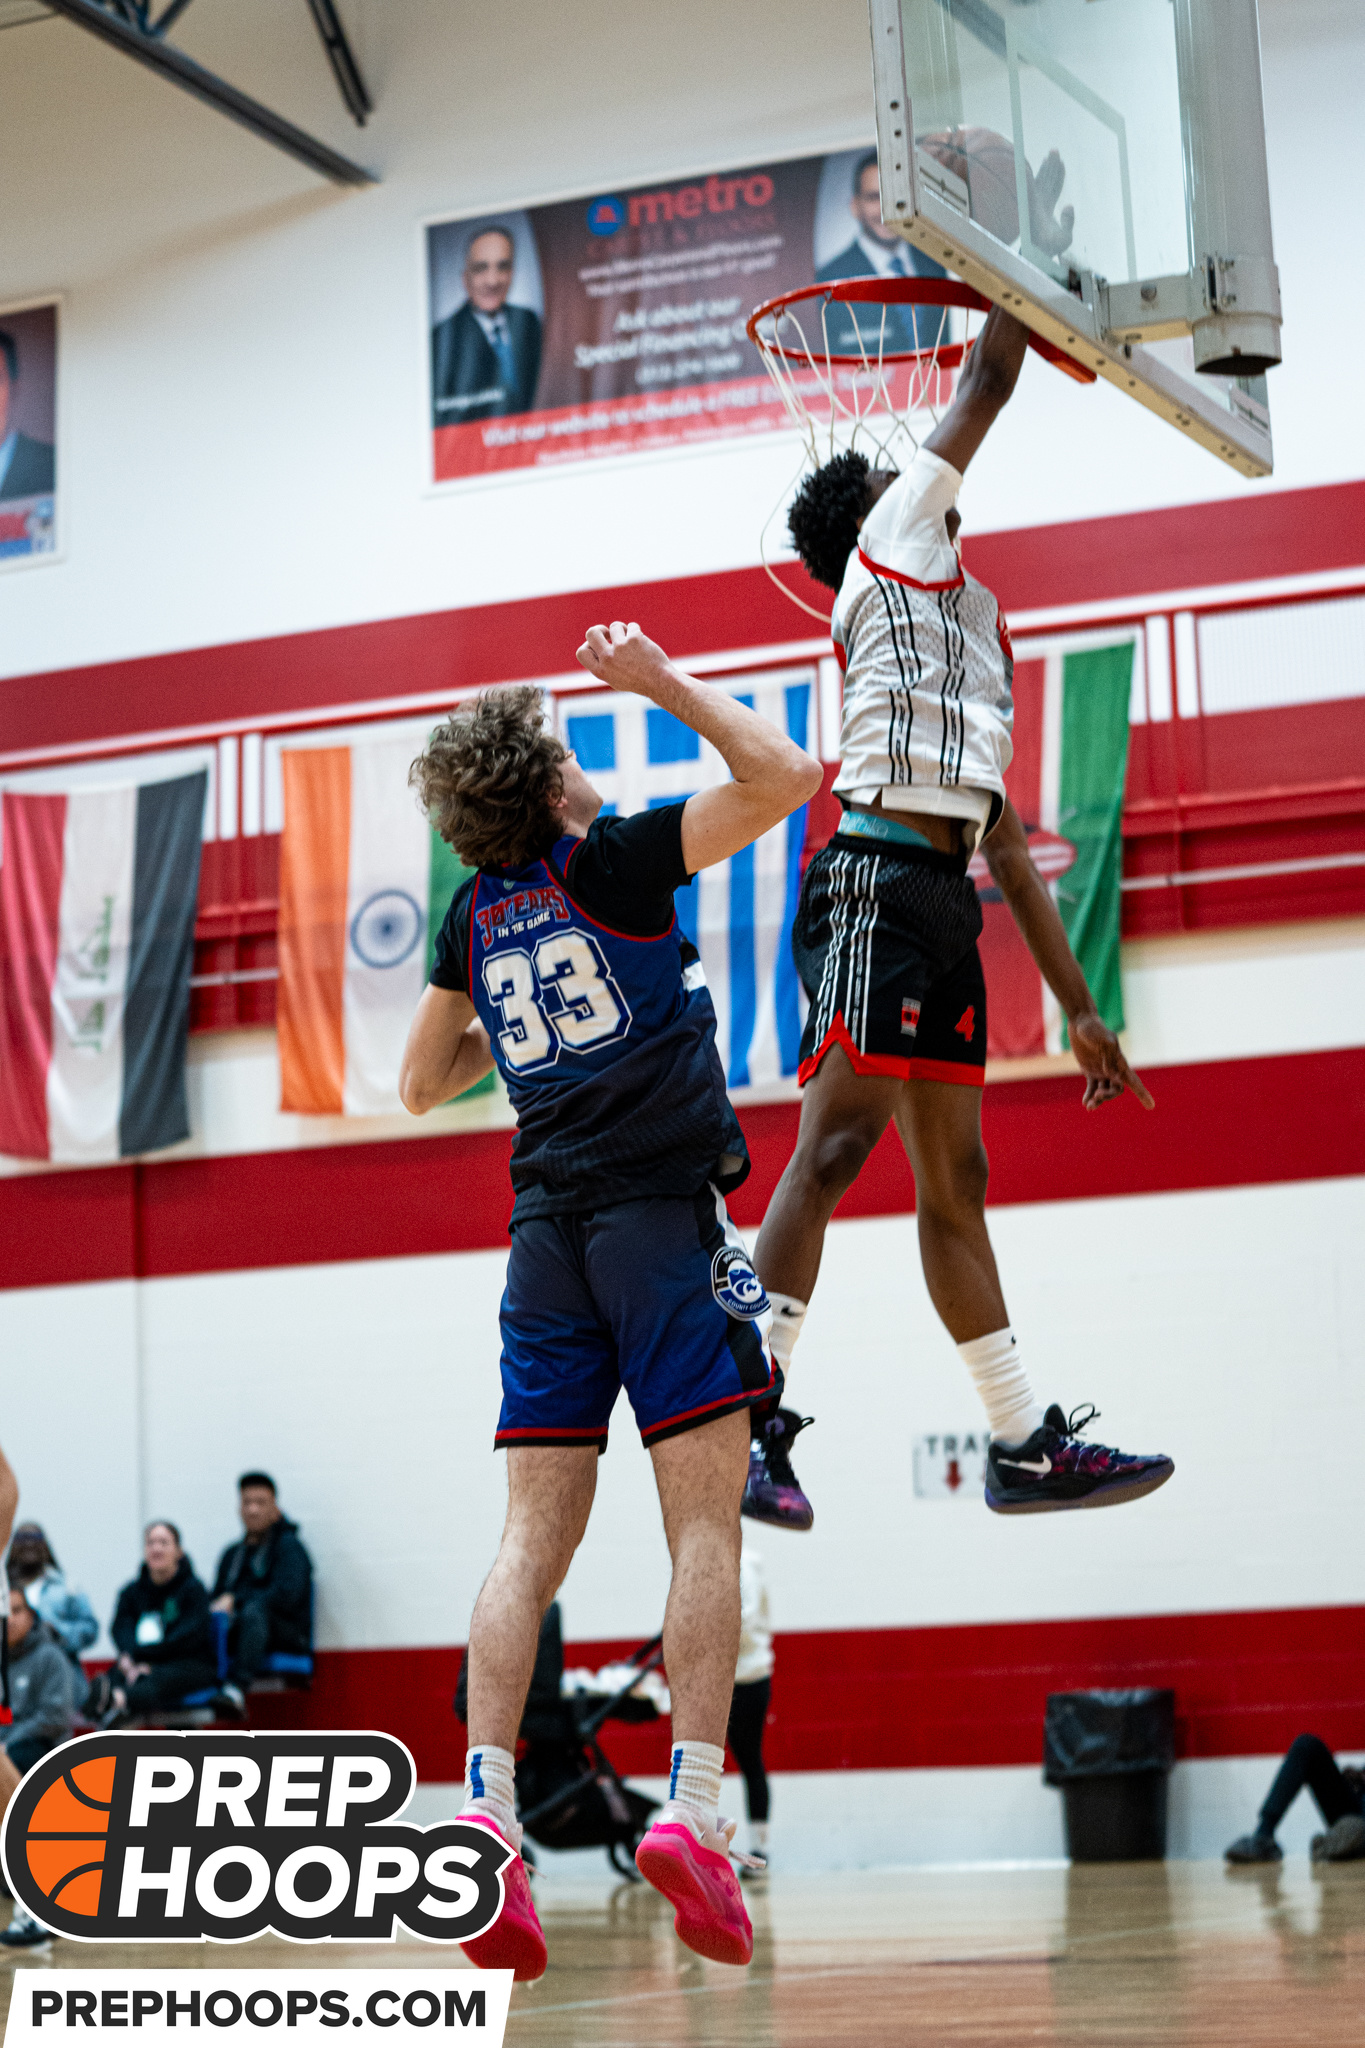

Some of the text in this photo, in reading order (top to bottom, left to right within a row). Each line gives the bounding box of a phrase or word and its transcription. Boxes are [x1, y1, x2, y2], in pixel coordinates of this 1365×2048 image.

[628, 174, 774, 226] metro
[498, 927, 509, 938] IN
[527, 911, 551, 930] GAME
[482, 927, 632, 1076] 33
[954, 1005, 975, 1042] 4
